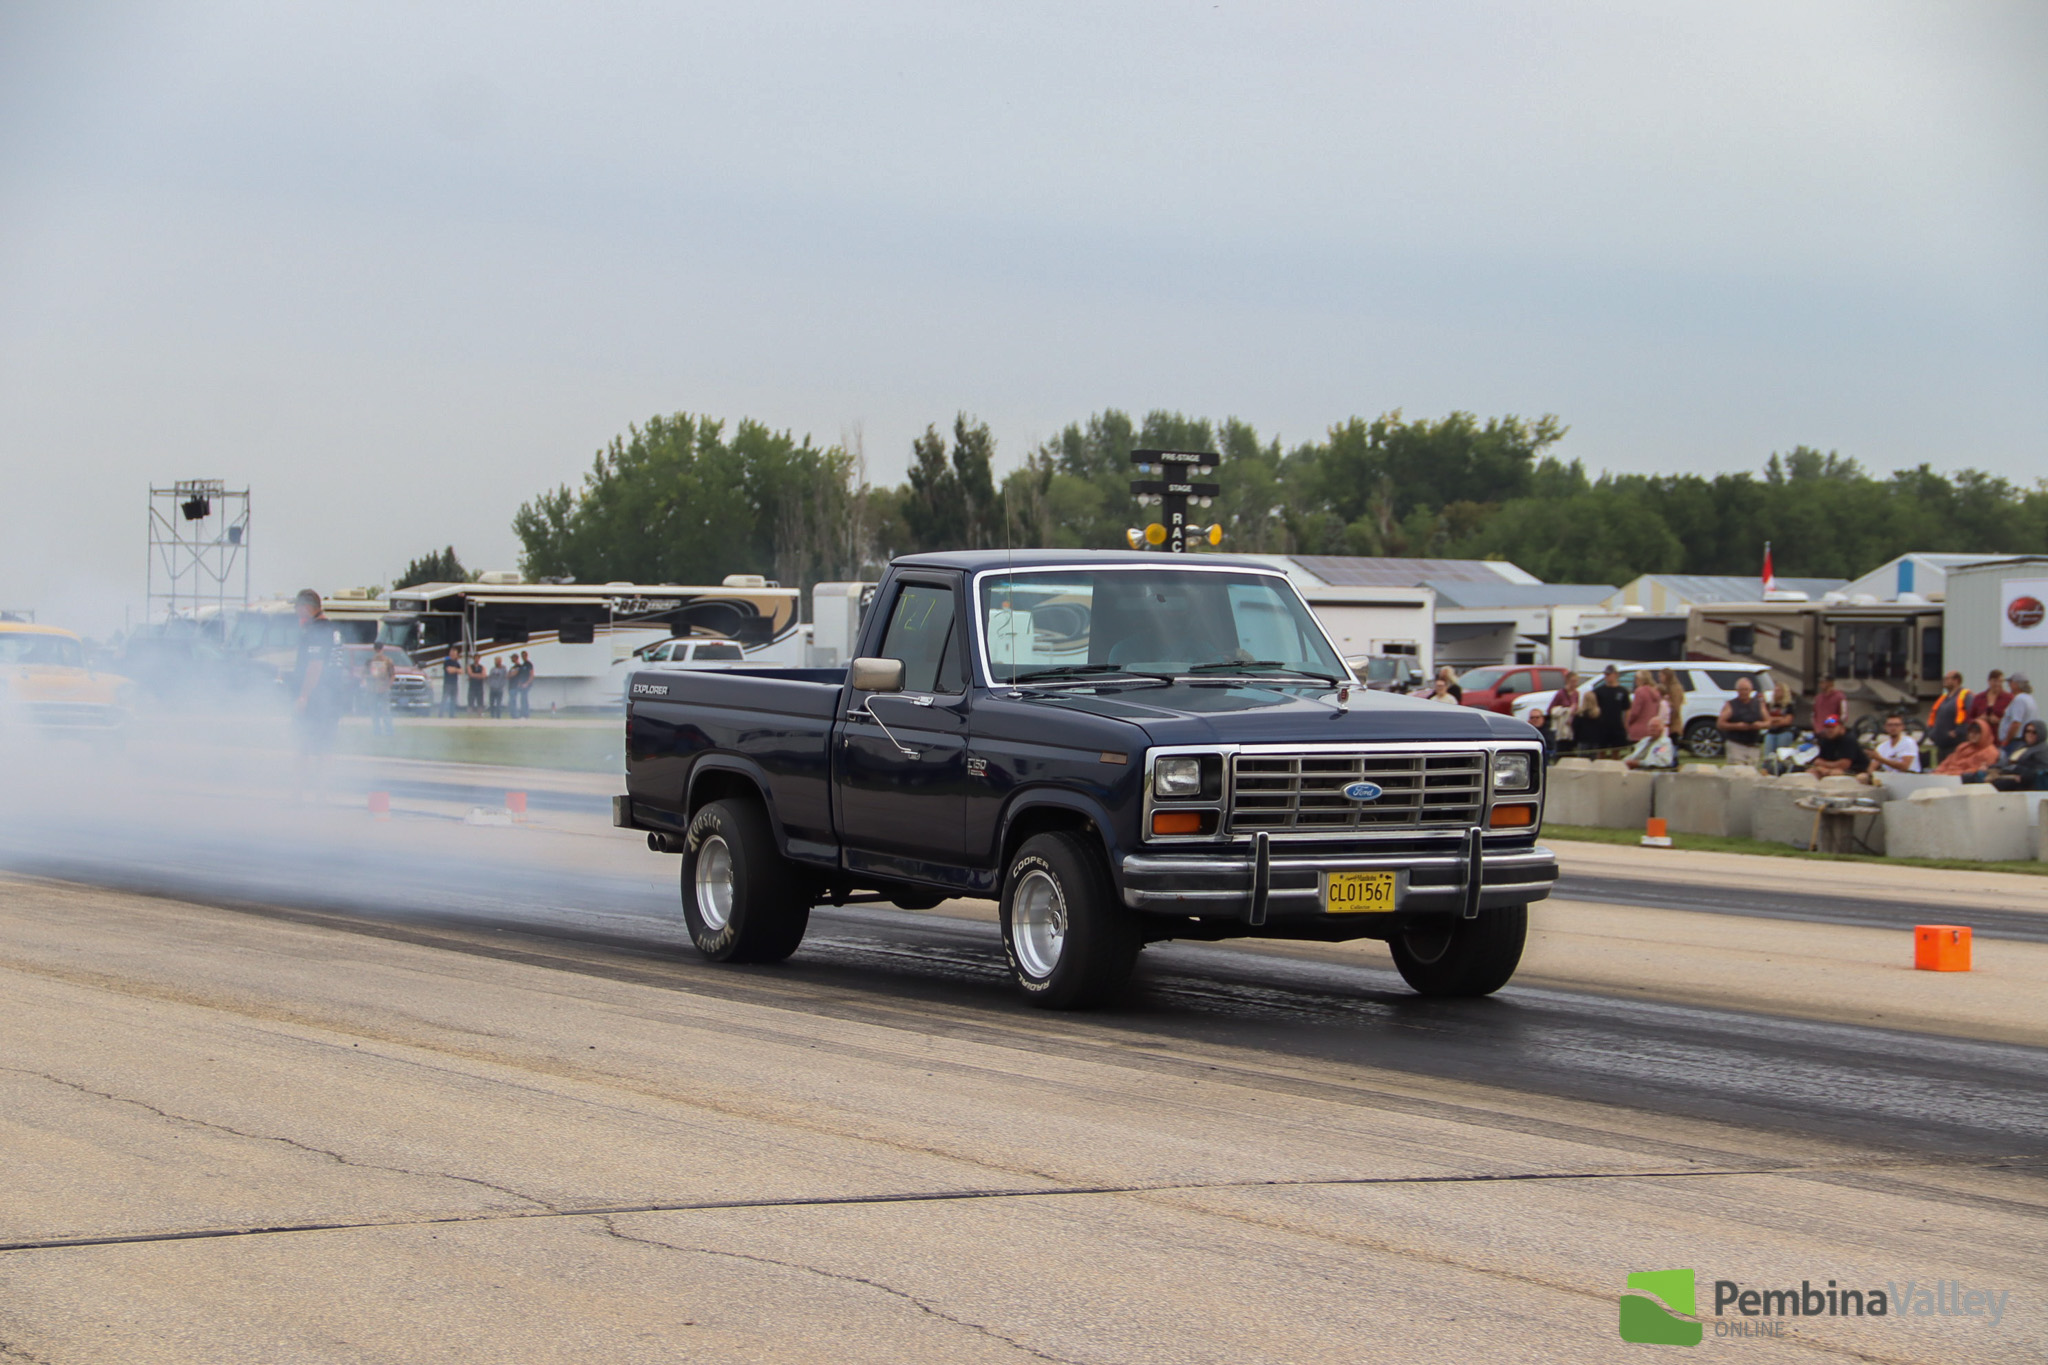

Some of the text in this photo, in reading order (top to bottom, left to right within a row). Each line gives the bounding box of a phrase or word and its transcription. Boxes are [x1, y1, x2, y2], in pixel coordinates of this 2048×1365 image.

[1161, 453, 1200, 462] PRE-STAGE
[1168, 484, 1193, 492] STAGE
[633, 684, 668, 695] EXPLORER
[1352, 786, 1374, 796] Ford
[1013, 856, 1049, 878] COOPER
[1018, 971, 1051, 992] RADIAL
